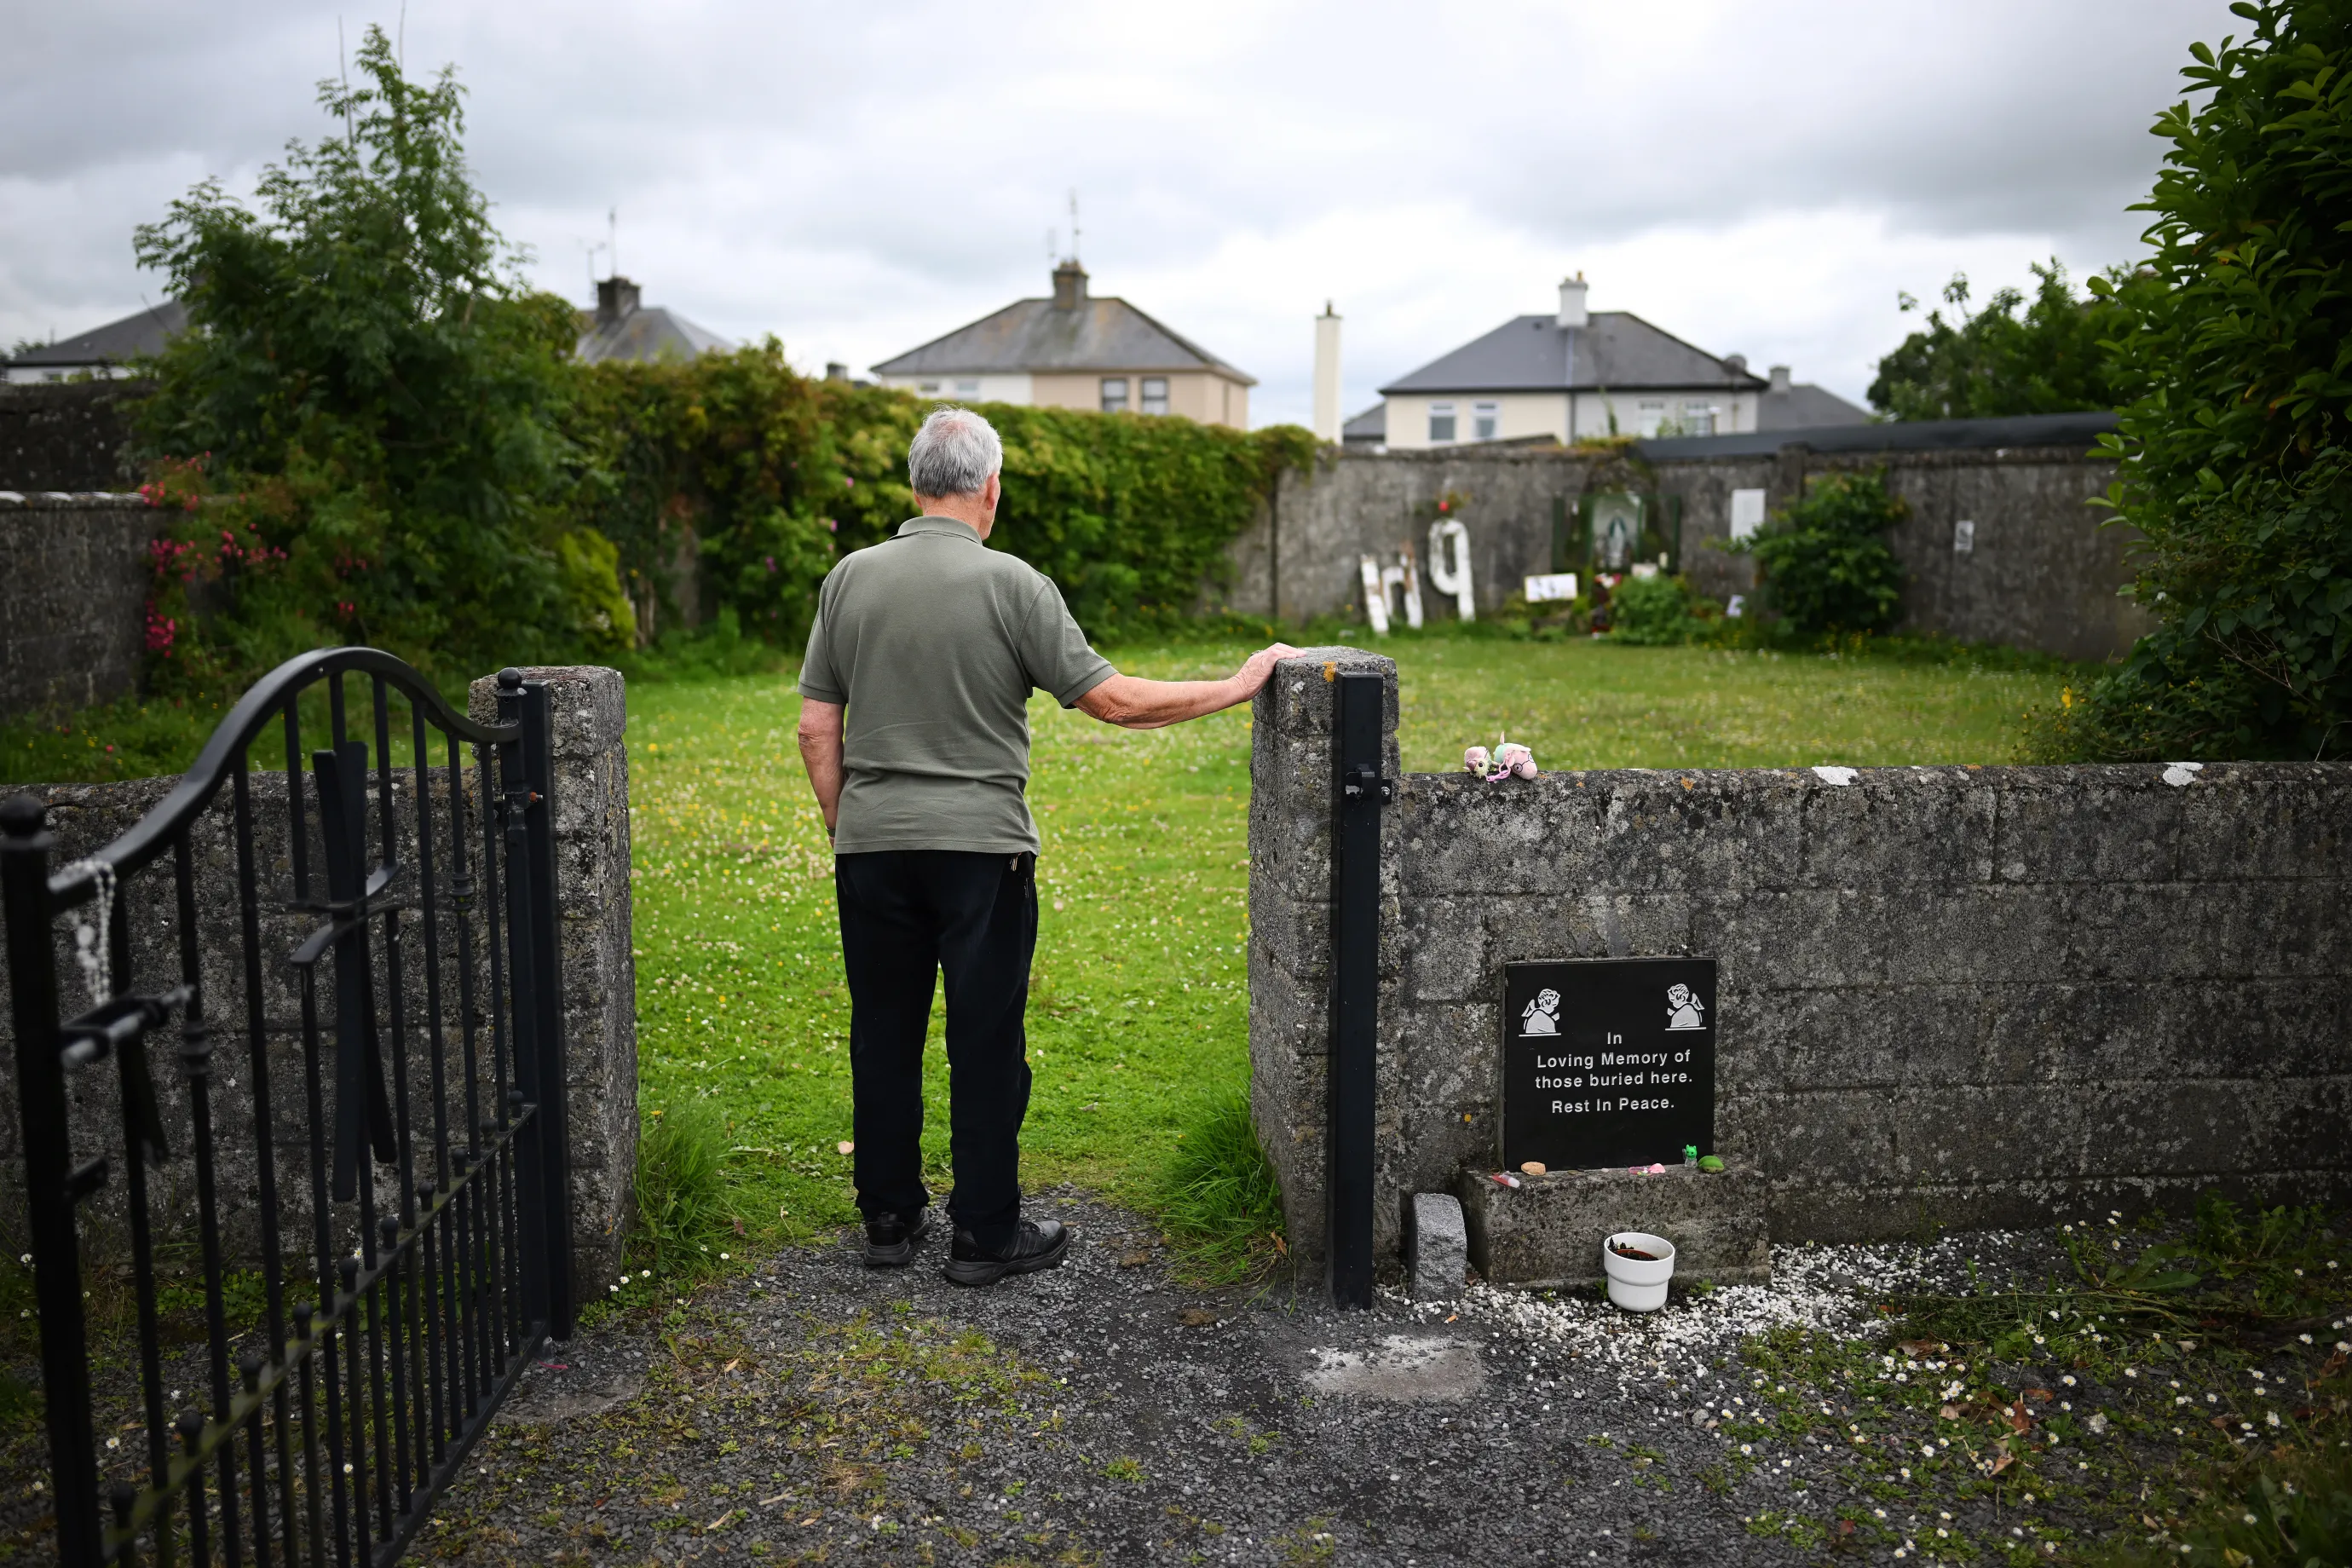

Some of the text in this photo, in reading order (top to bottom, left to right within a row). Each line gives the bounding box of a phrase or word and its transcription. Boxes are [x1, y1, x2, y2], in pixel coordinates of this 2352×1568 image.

[1607, 1031, 1623, 1045] In
[1536, 1048, 1691, 1069] Loving Memory of
[1535, 1070, 1693, 1089] those buried here.
[1552, 1097, 1675, 1114] Rest In Peace.
